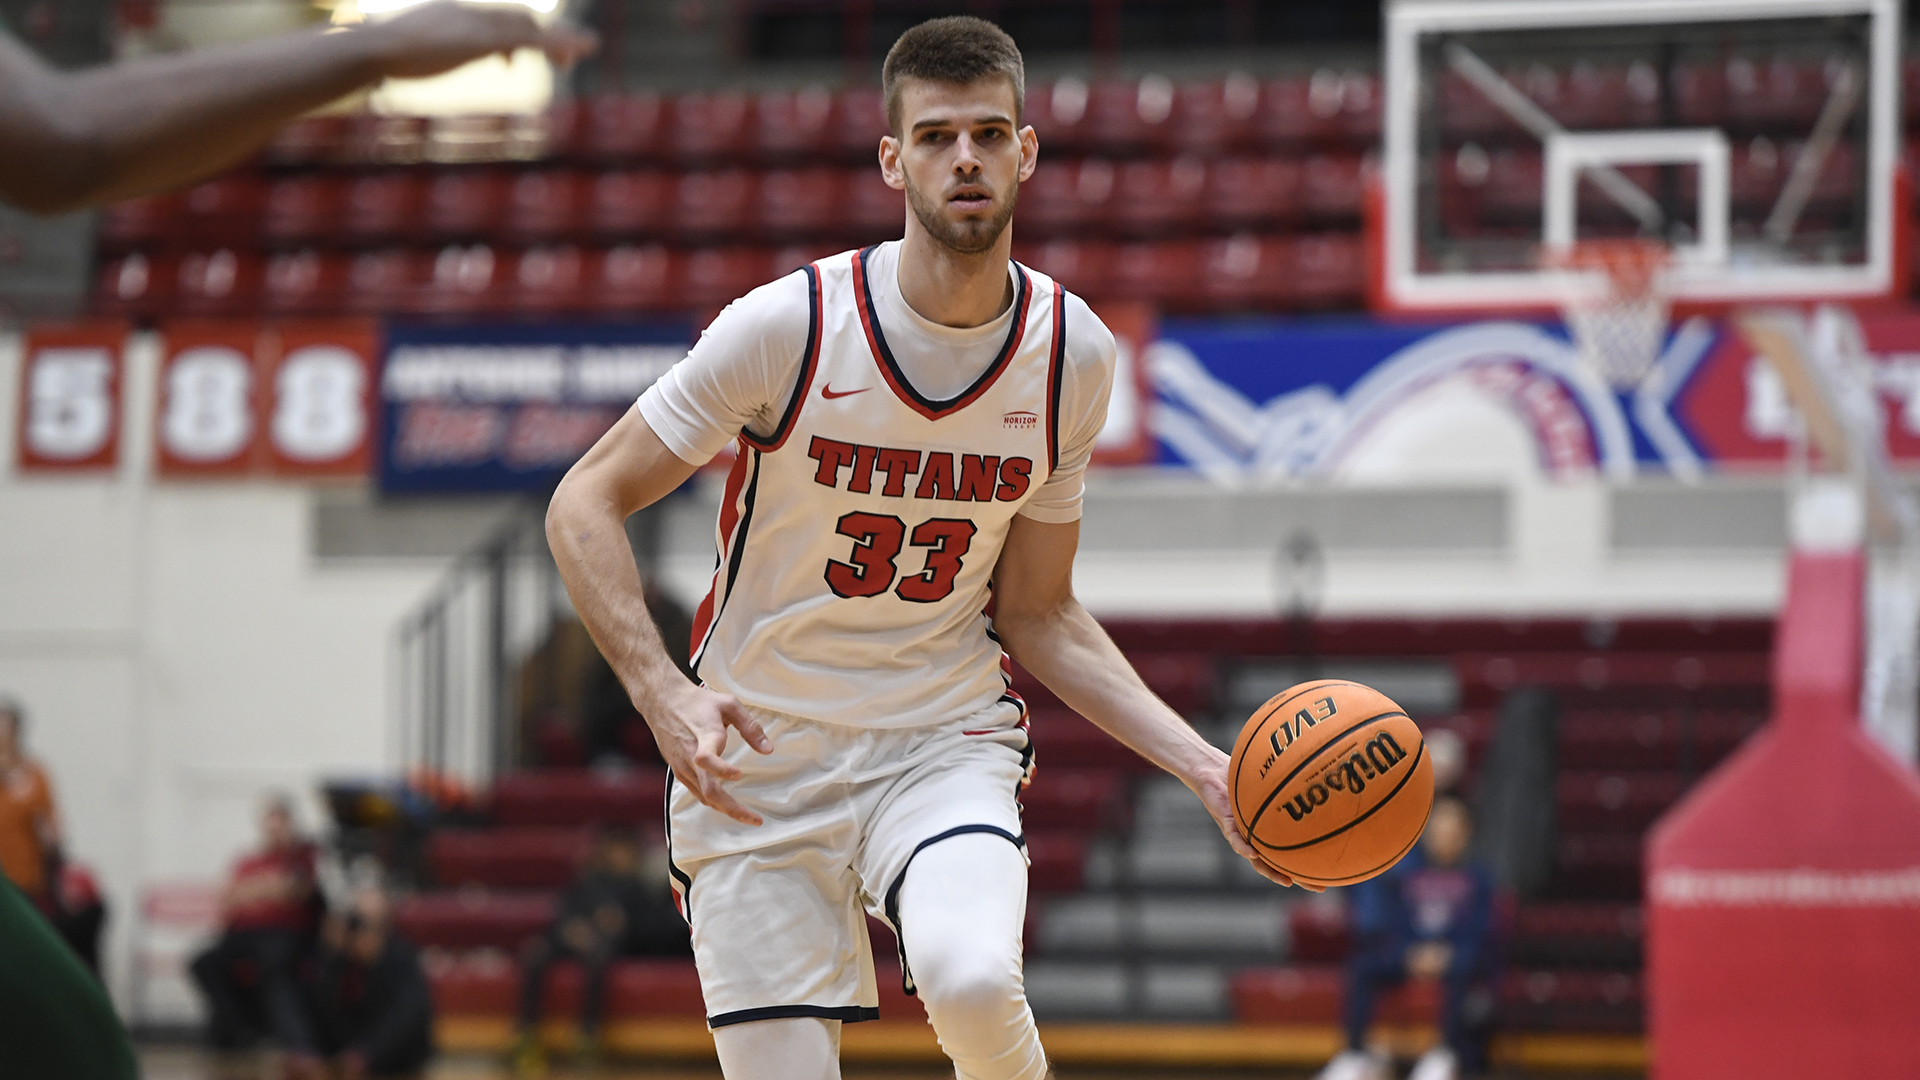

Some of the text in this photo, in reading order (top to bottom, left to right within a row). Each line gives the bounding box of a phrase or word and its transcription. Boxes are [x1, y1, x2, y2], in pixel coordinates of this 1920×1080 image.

[1004, 416, 1037, 424] HORIZON
[807, 434, 1033, 503] TITANS
[823, 510, 978, 604] 33
[1269, 696, 1338, 757] EVO
[1259, 753, 1277, 781] NXT
[1282, 731, 1408, 821] Wilson
